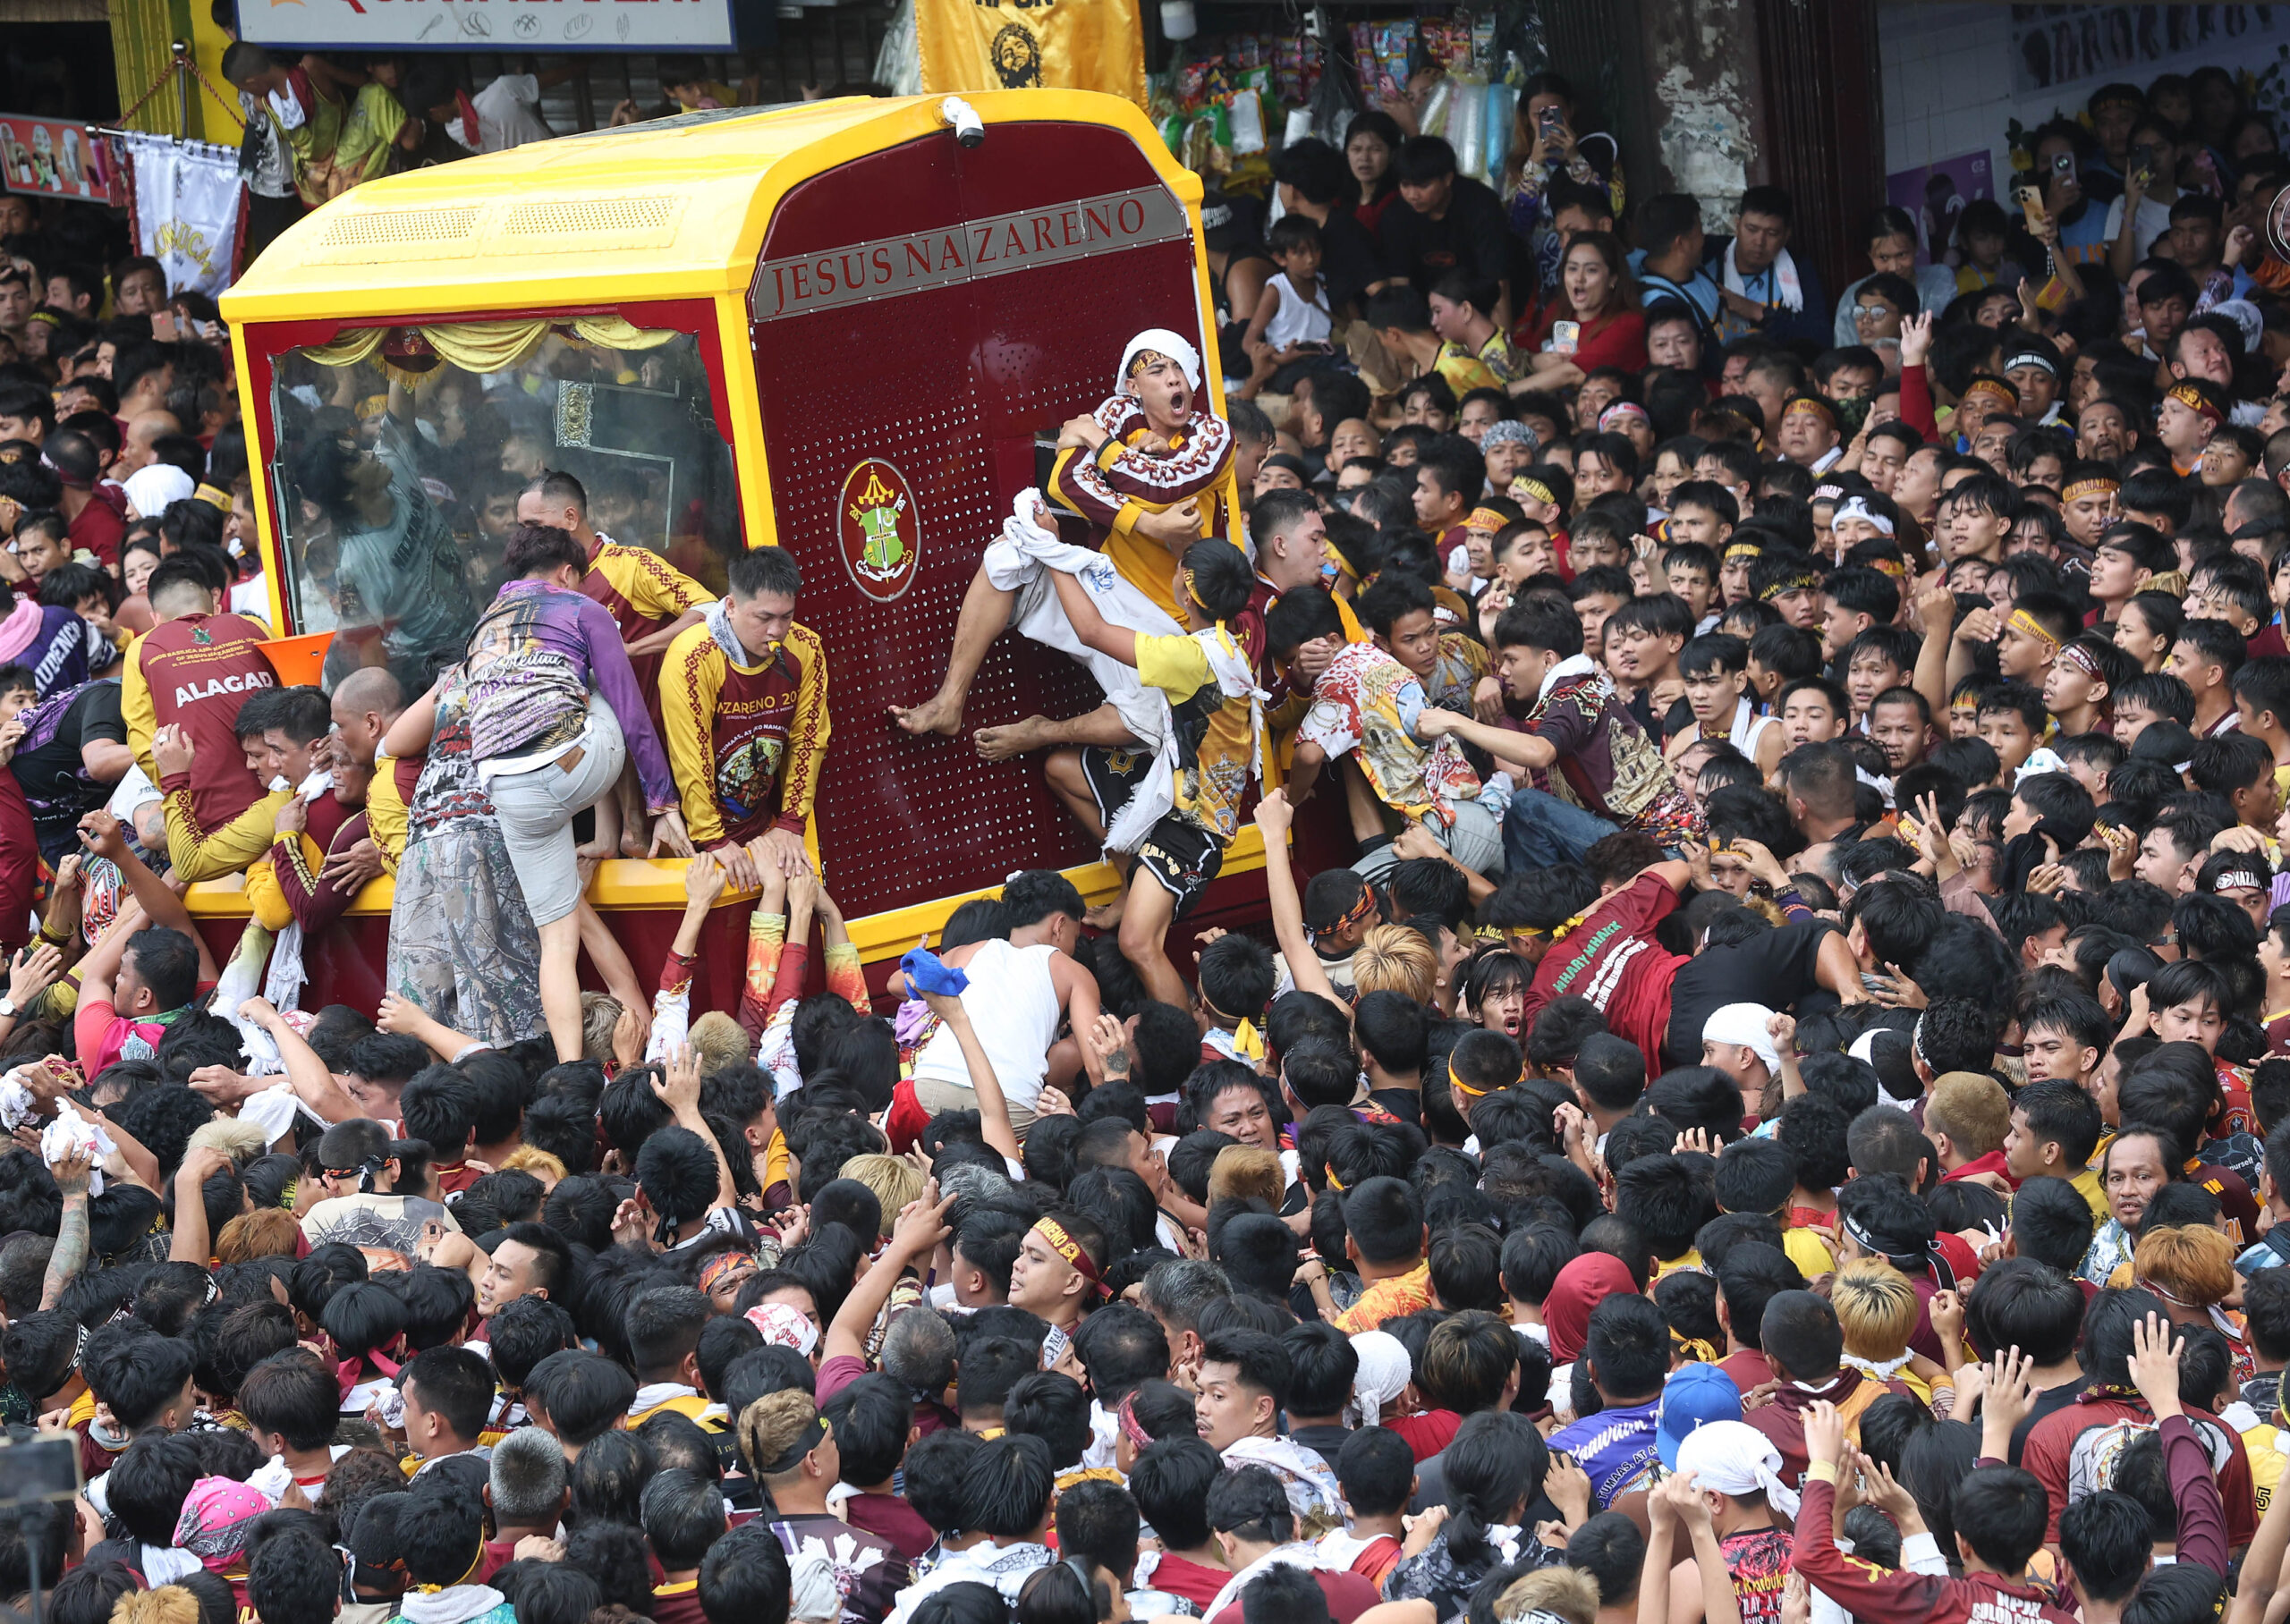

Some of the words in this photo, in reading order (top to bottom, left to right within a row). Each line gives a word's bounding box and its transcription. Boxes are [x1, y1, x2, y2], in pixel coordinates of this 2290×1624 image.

[772, 247, 893, 314] JESUS
[167, 647, 198, 658] BASILICA
[213, 639, 246, 651] NATIONAL
[186, 653, 208, 661] JESUS
[208, 645, 245, 658] NAZARENO
[174, 671, 274, 709] ALAGAD
[1596, 1460, 1636, 1501] TUMAAS,
[1633, 1449, 1647, 1464] AT
[2254, 1485, 2271, 1511] 5
